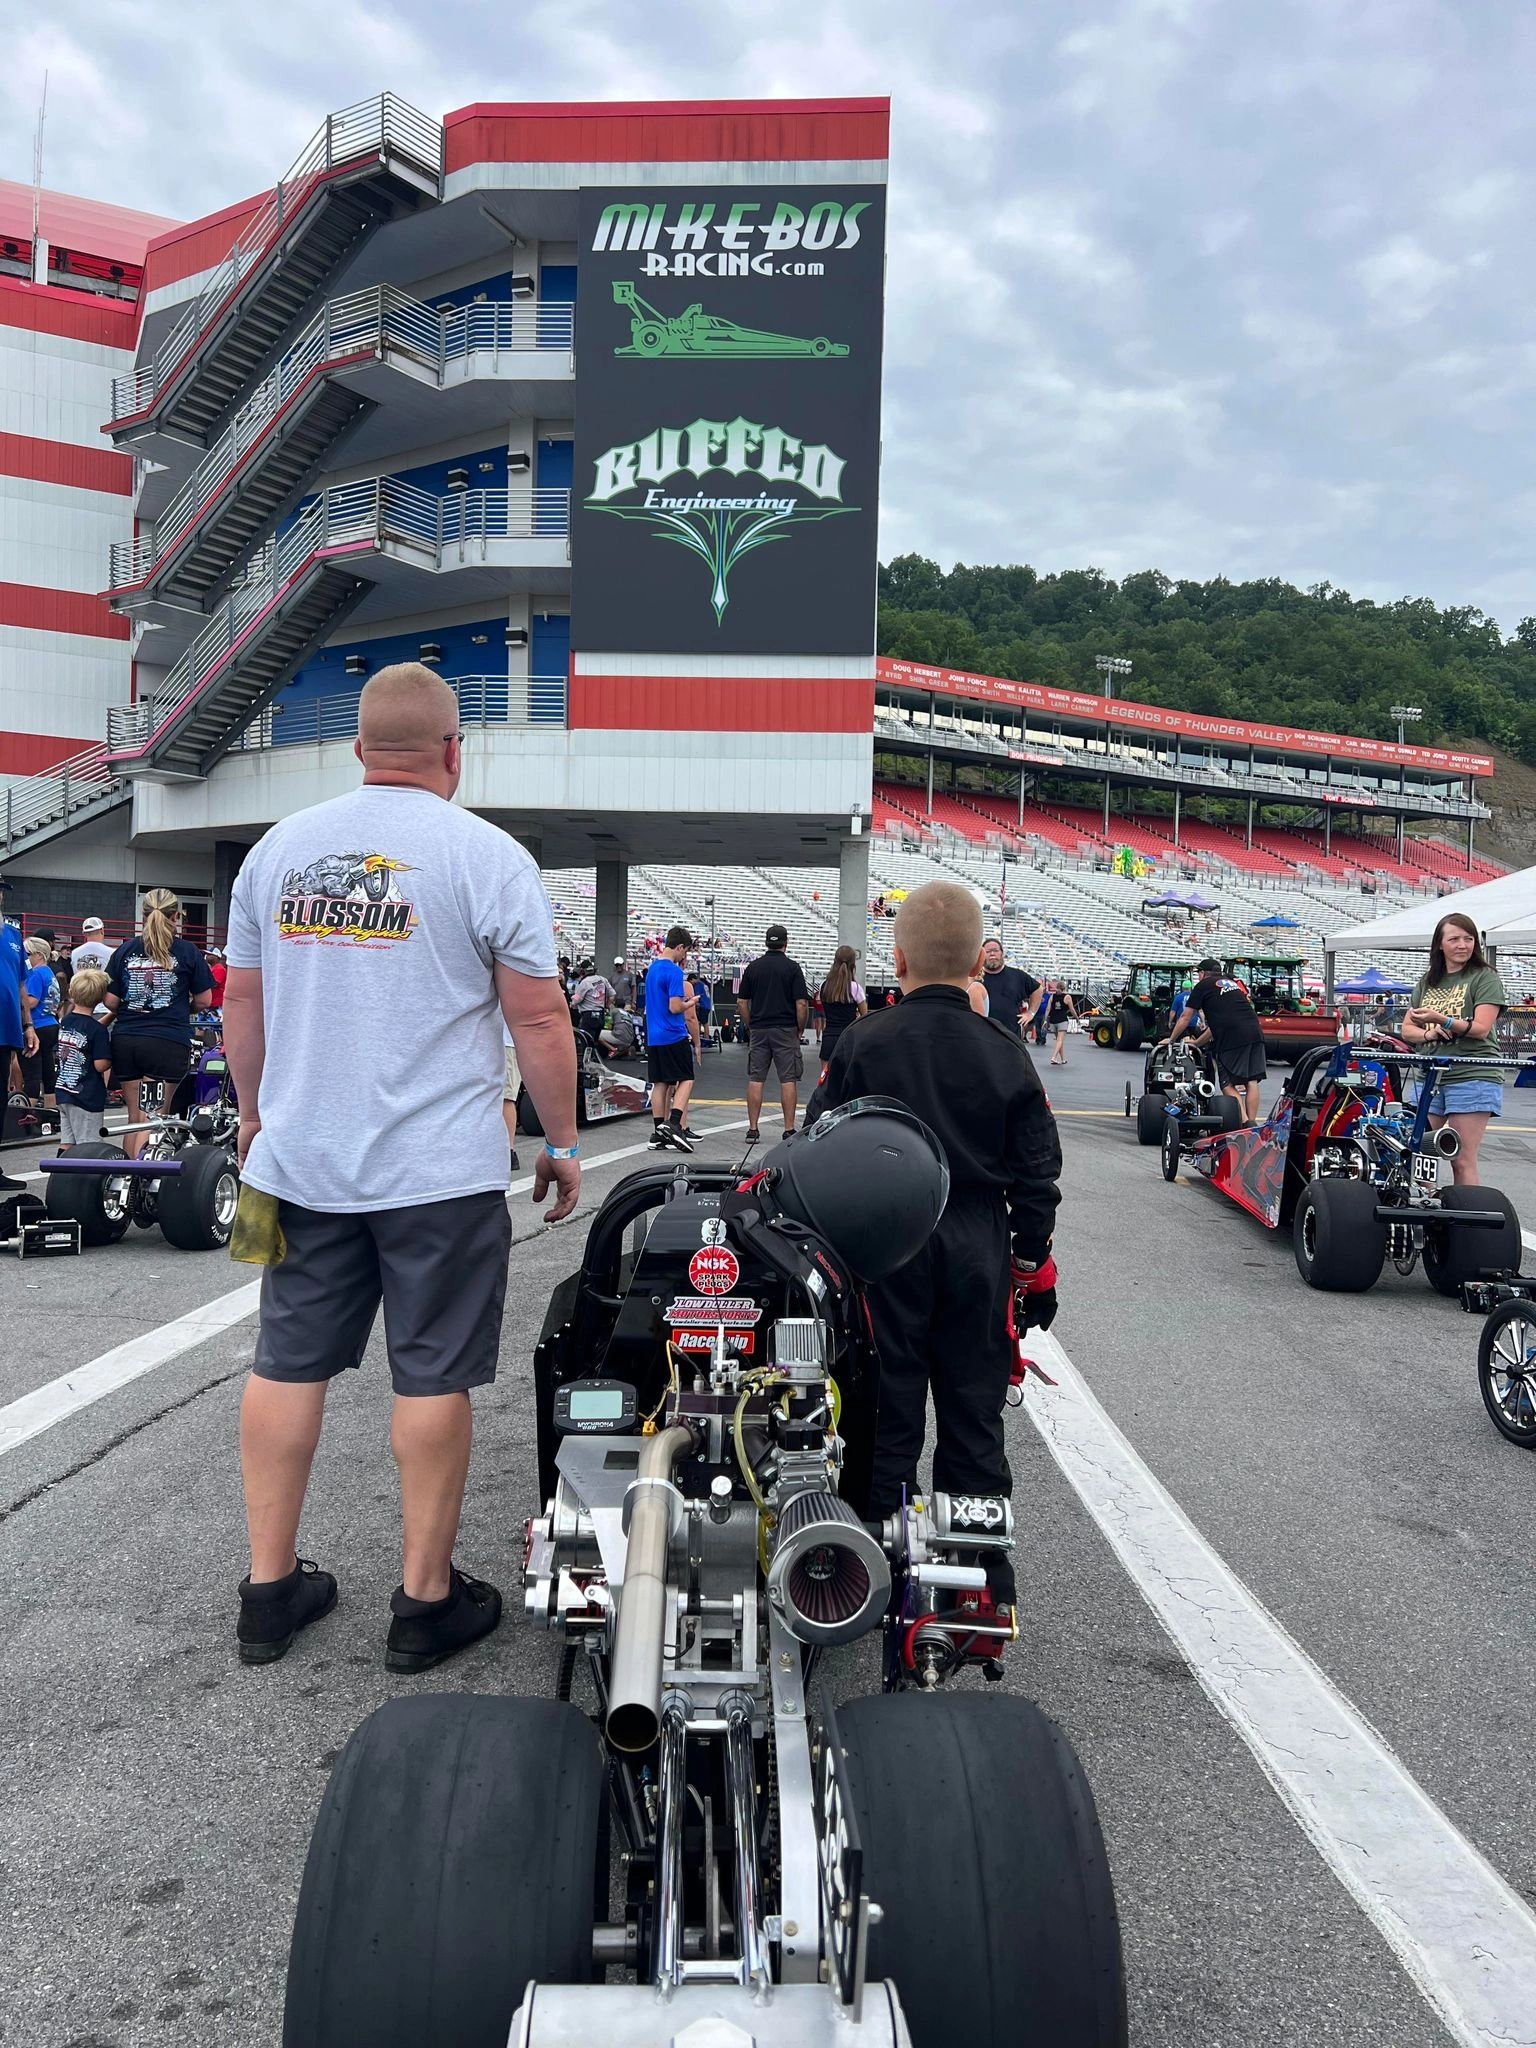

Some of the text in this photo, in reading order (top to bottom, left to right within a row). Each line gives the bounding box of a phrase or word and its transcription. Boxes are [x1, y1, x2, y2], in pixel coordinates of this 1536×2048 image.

[584, 416, 848, 502] BUFFCO
[643, 489, 797, 515] Engineering
[892, 663, 942, 678] DOUG HERBERT
[948, 674, 988, 687] JOHN FORCE
[982, 688, 1000, 697] SMITH
[993, 681, 1042, 697] CONNIE KALITTA
[1047, 692, 1098, 707] WARREN JOHNSON
[1104, 705, 1292, 743] LEGENDS OF THUNDER VALLEY
[1294, 732, 1341, 745] DON SCHUMACHER
[1382, 745, 1417, 756] MARK OSWALD
[1421, 750, 1448, 760] TED JONES
[1451, 755, 1470, 764] SCOTTY
[280, 898, 412, 933] BLOSSOM
[279, 922, 337, 940] Racing
[1414, 1156, 1438, 1182] 8.93
[696, 1257, 730, 1271] NGK
